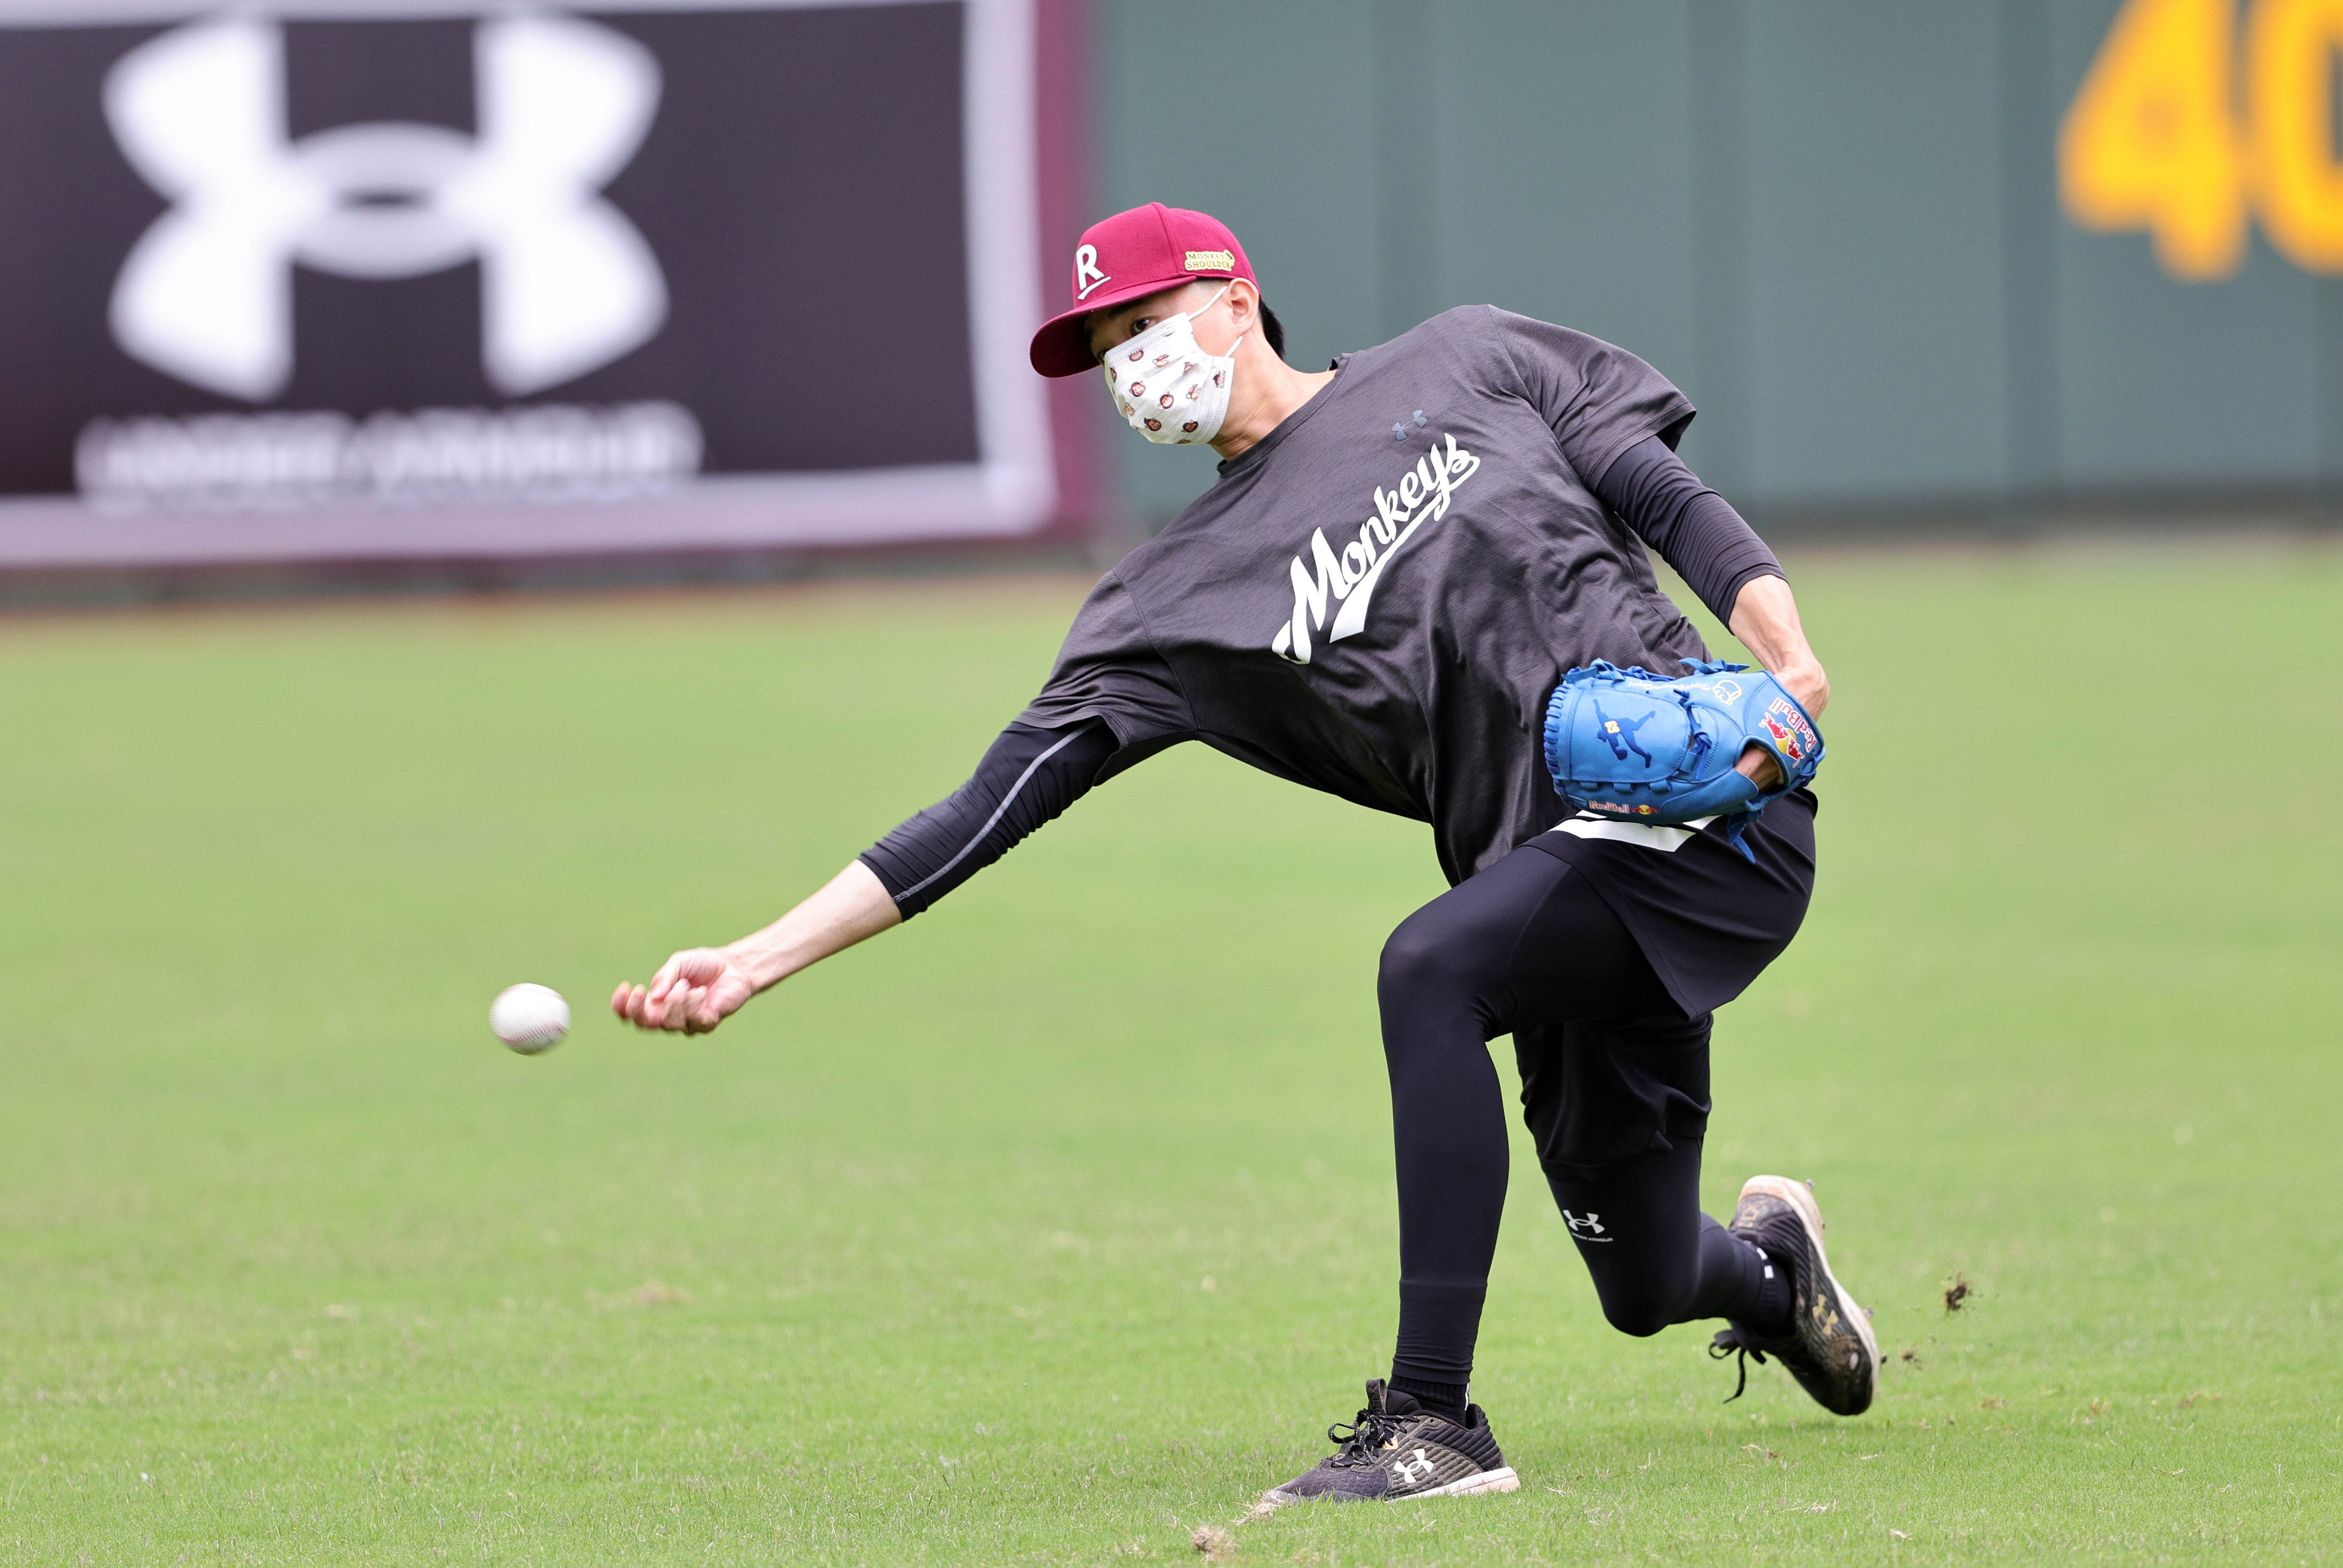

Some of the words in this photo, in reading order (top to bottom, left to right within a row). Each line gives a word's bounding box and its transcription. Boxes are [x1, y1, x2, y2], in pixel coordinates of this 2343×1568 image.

[1076, 244, 1105, 290] R
[1187, 261, 1230, 269] SHOULDER
[1272, 433, 1480, 665] Monkeys
